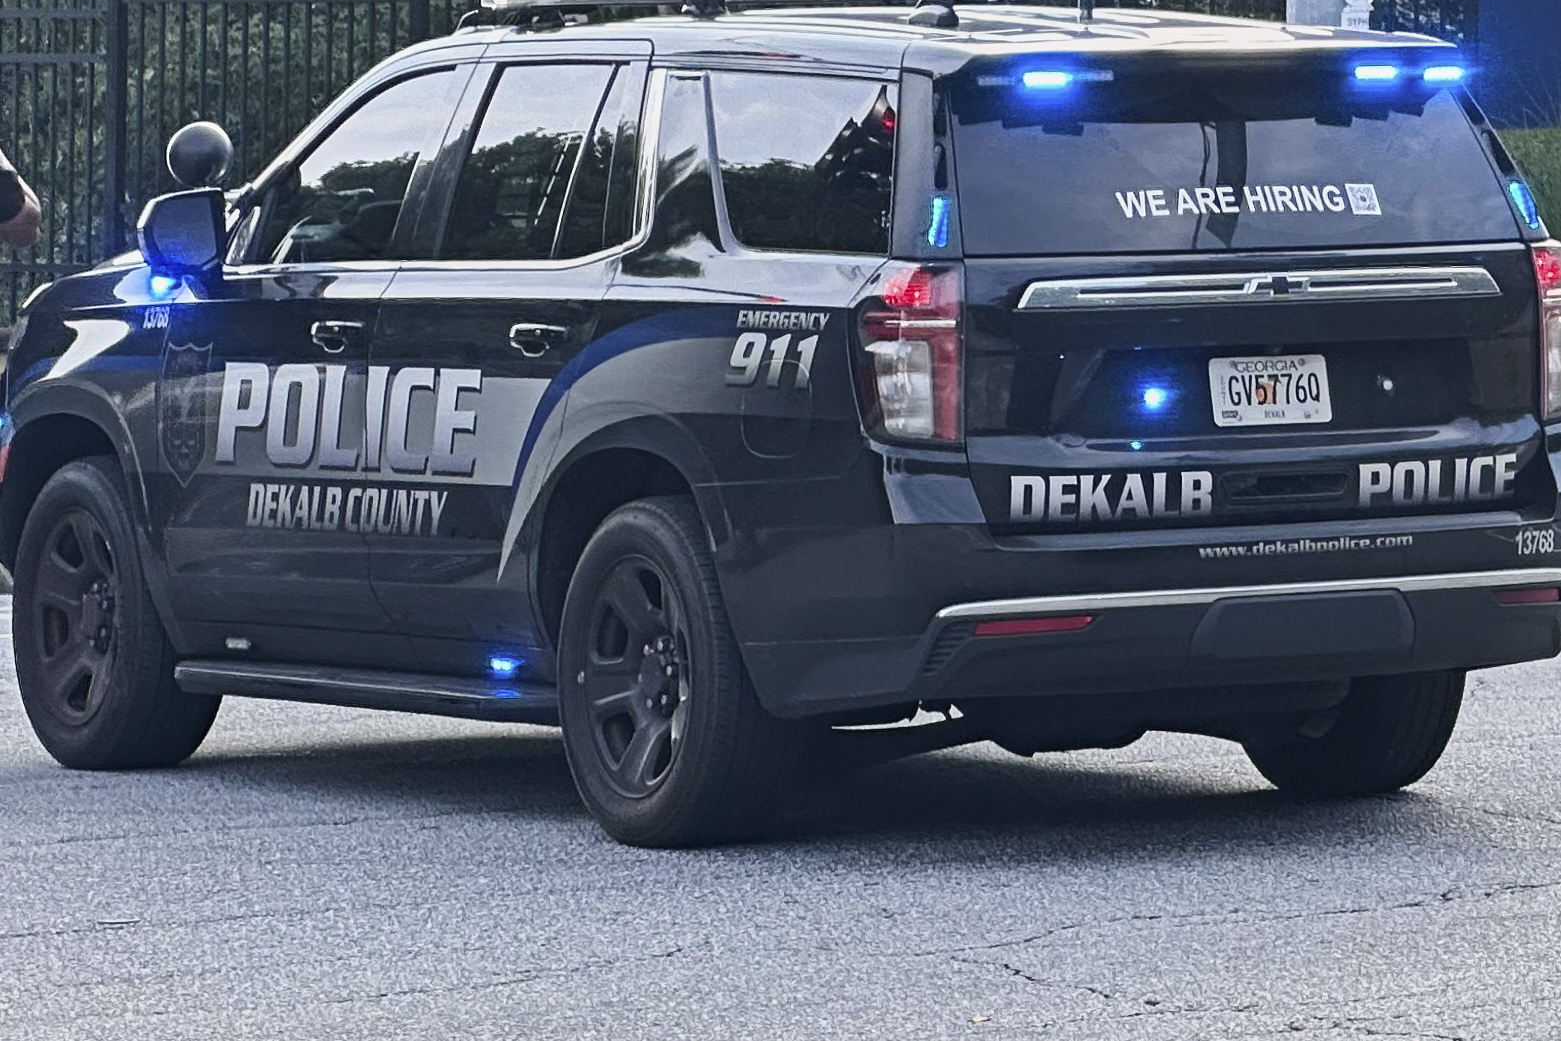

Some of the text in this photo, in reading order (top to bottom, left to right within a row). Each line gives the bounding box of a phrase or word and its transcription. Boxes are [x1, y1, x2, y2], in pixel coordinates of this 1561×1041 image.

[1115, 184, 1346, 219] WE ARE HIRING
[736, 309, 831, 331] EMERGENCY
[724, 331, 819, 390] 911
[1235, 360, 1298, 373] GEORGIA
[216, 361, 482, 478] POLICE
[1009, 453, 1517, 523] DEKALB POLICE
[246, 482, 449, 537] DEKALB COUNTY
[1198, 535, 1414, 559] www.dekalbpolice.com
[1515, 529, 1555, 555] 13768
